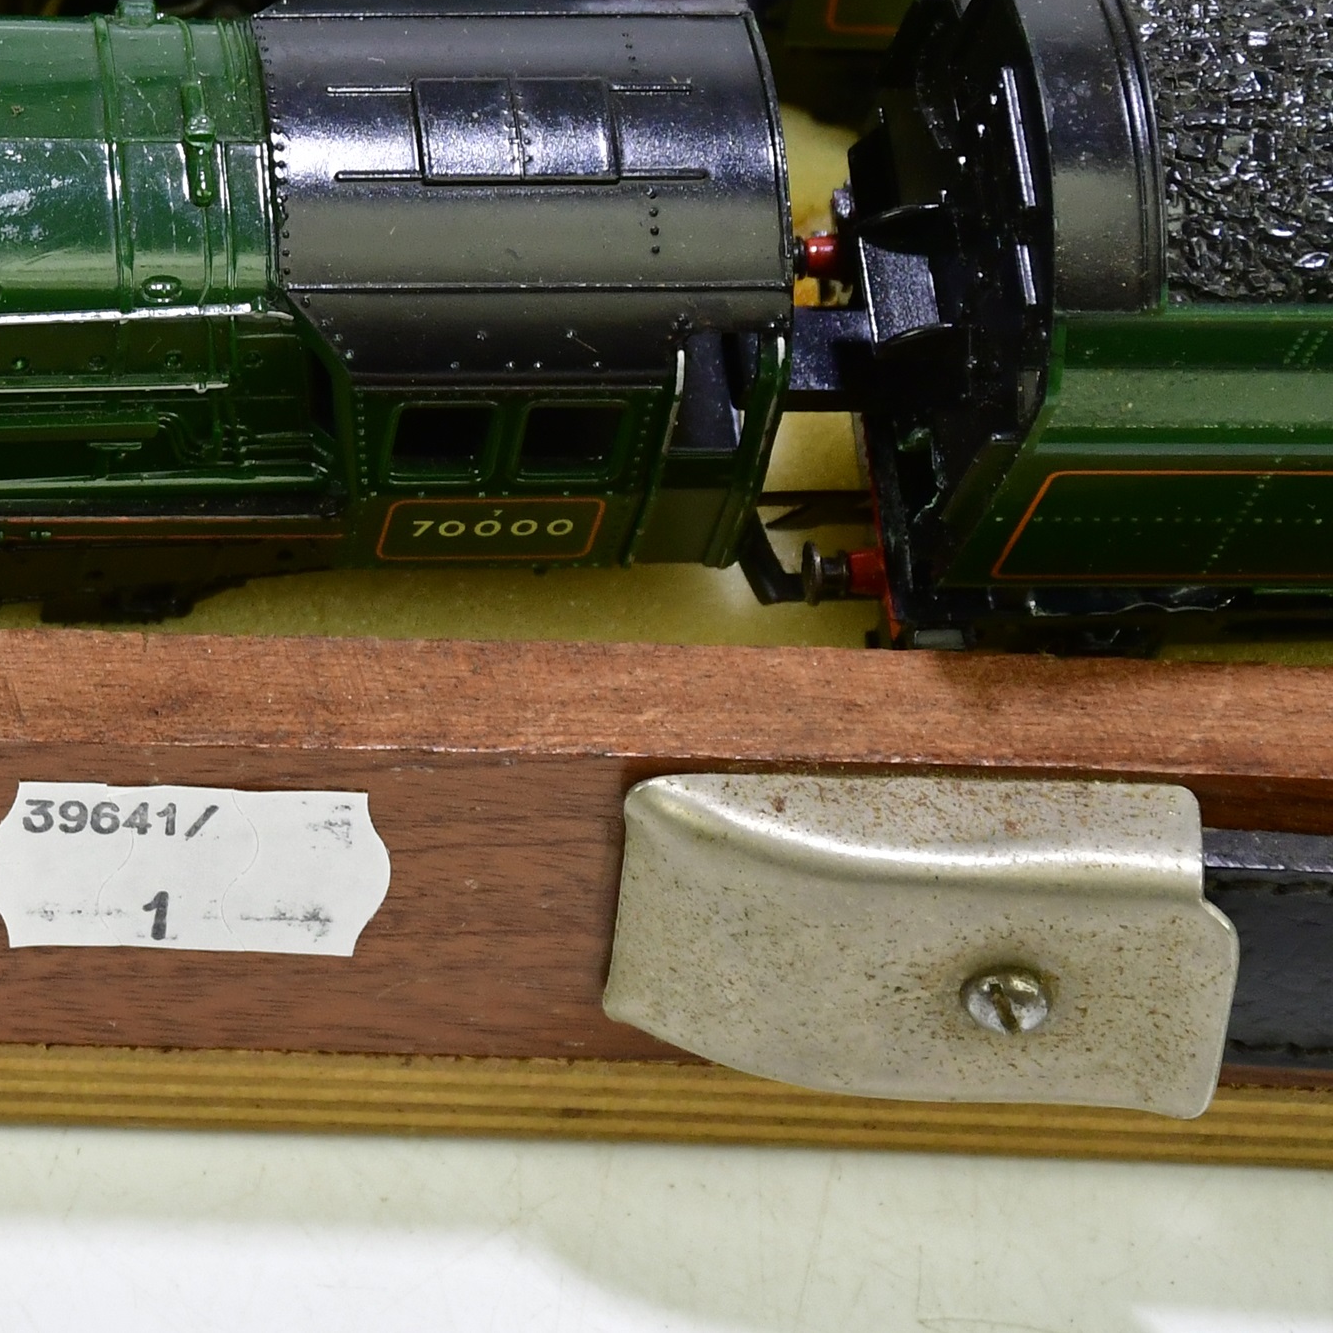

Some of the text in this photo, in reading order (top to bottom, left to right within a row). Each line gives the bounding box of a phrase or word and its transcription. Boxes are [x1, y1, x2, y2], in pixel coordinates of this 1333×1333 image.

[412, 519, 574, 537] 70000
[21, 798, 220, 841] 39641/
[142, 890, 170, 941] 1
